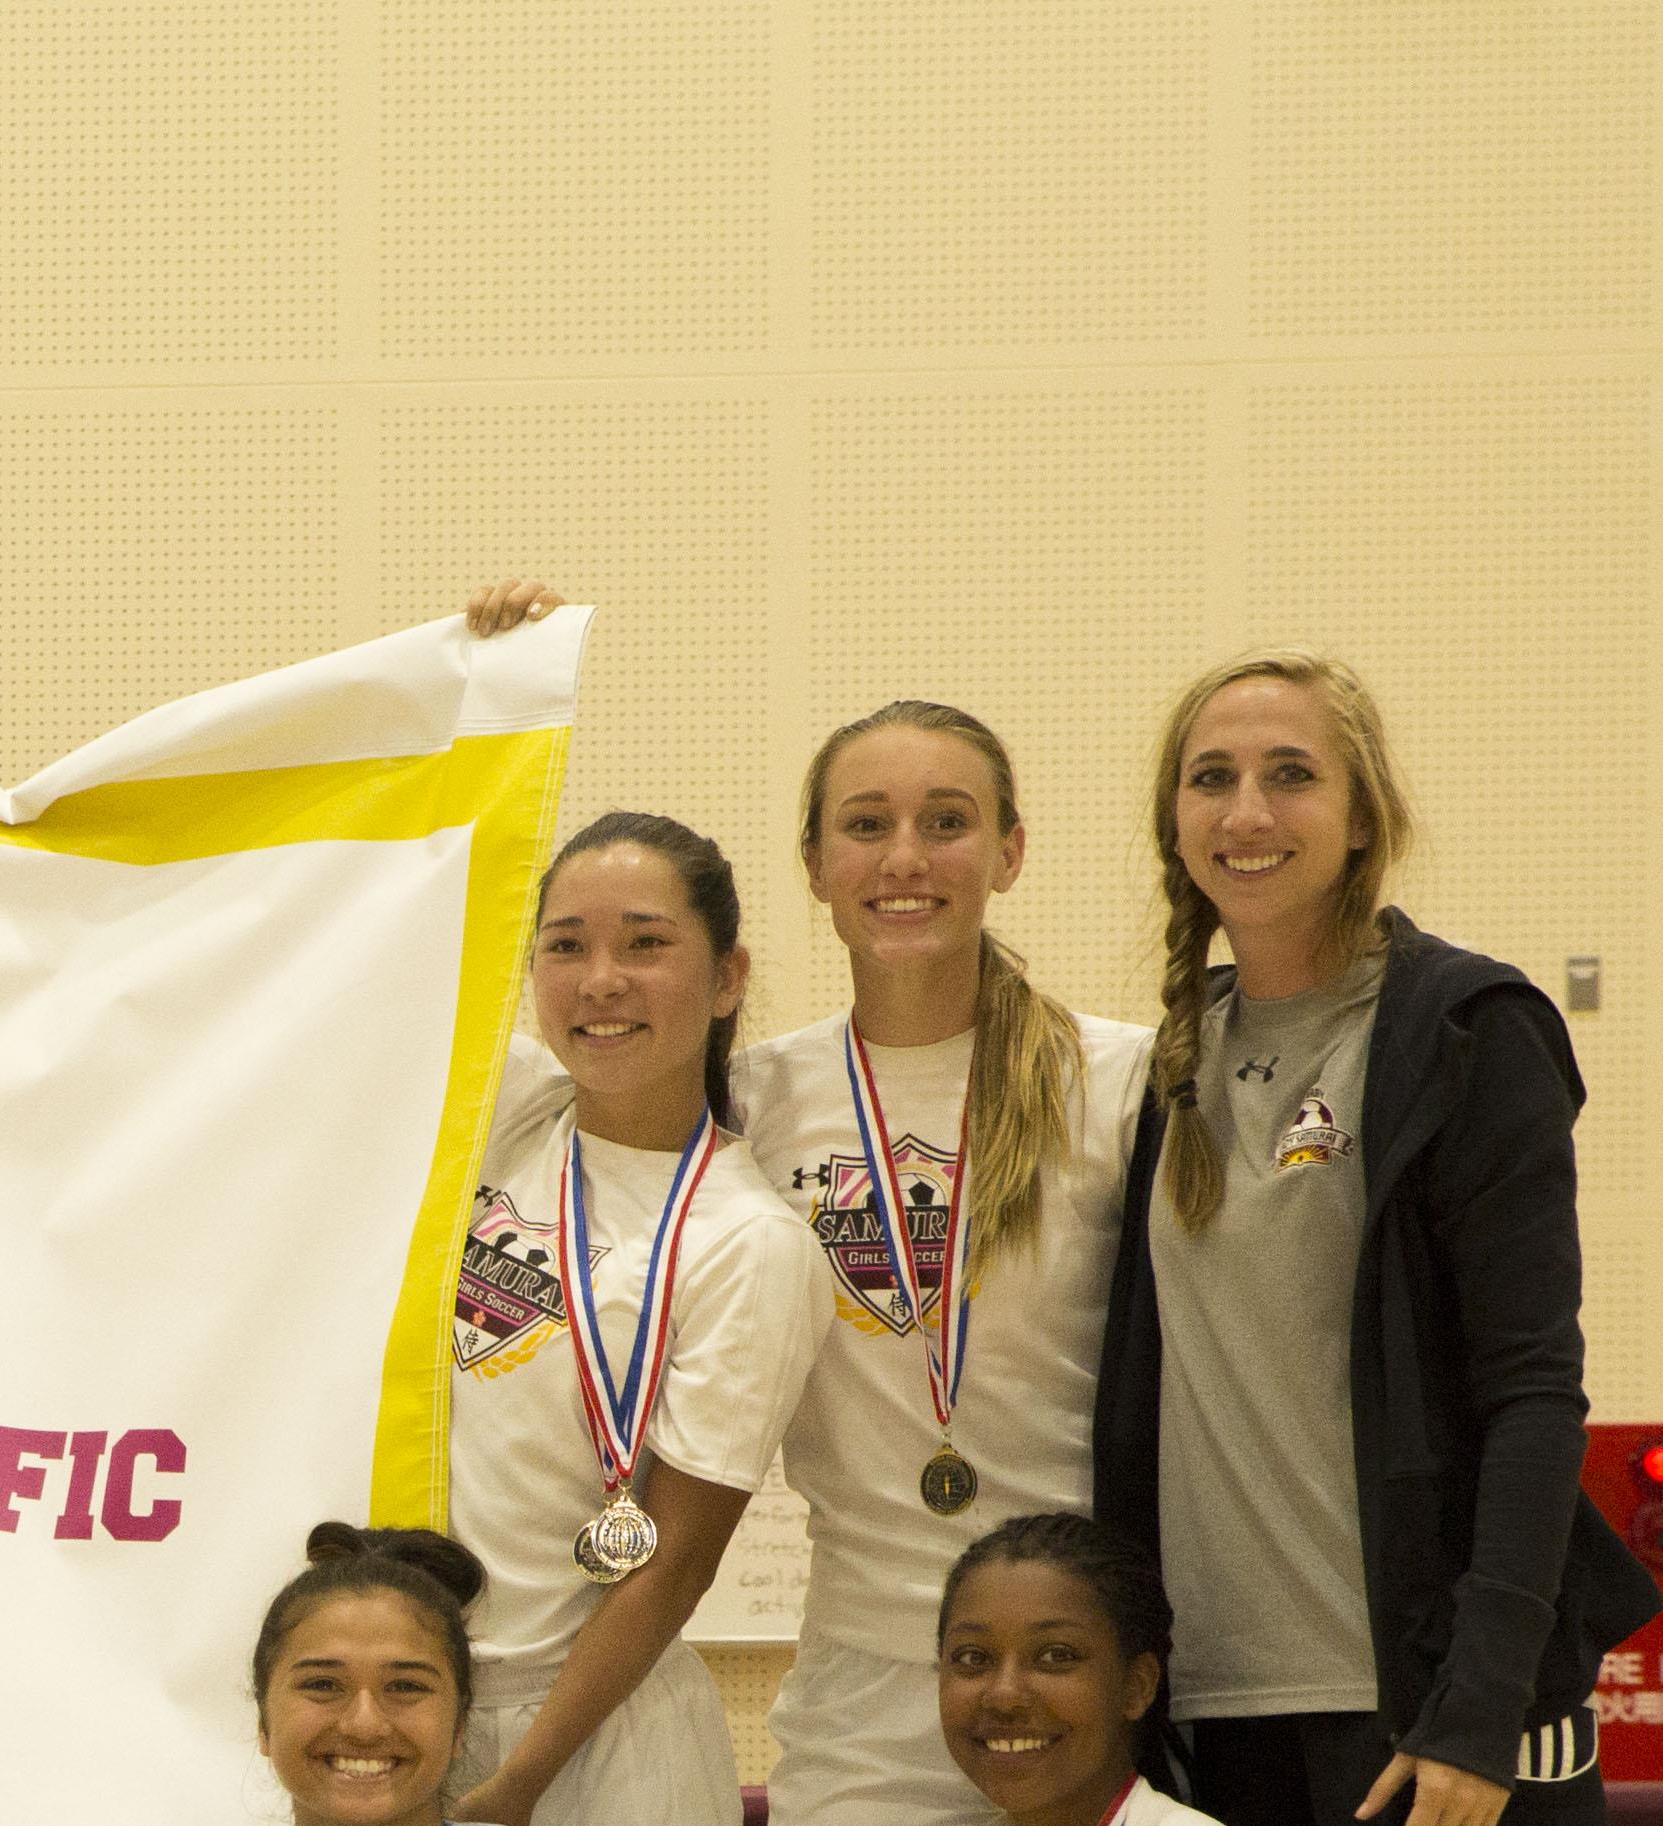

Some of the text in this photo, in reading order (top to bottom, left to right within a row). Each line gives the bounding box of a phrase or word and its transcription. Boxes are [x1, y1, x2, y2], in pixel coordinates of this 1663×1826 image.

[818, 1211, 947, 1244] SAMR
[848, 1251, 890, 1265] GIRLS
[462, 1244, 566, 1317] AMURA
[484, 1291, 526, 1321] SOCCER
